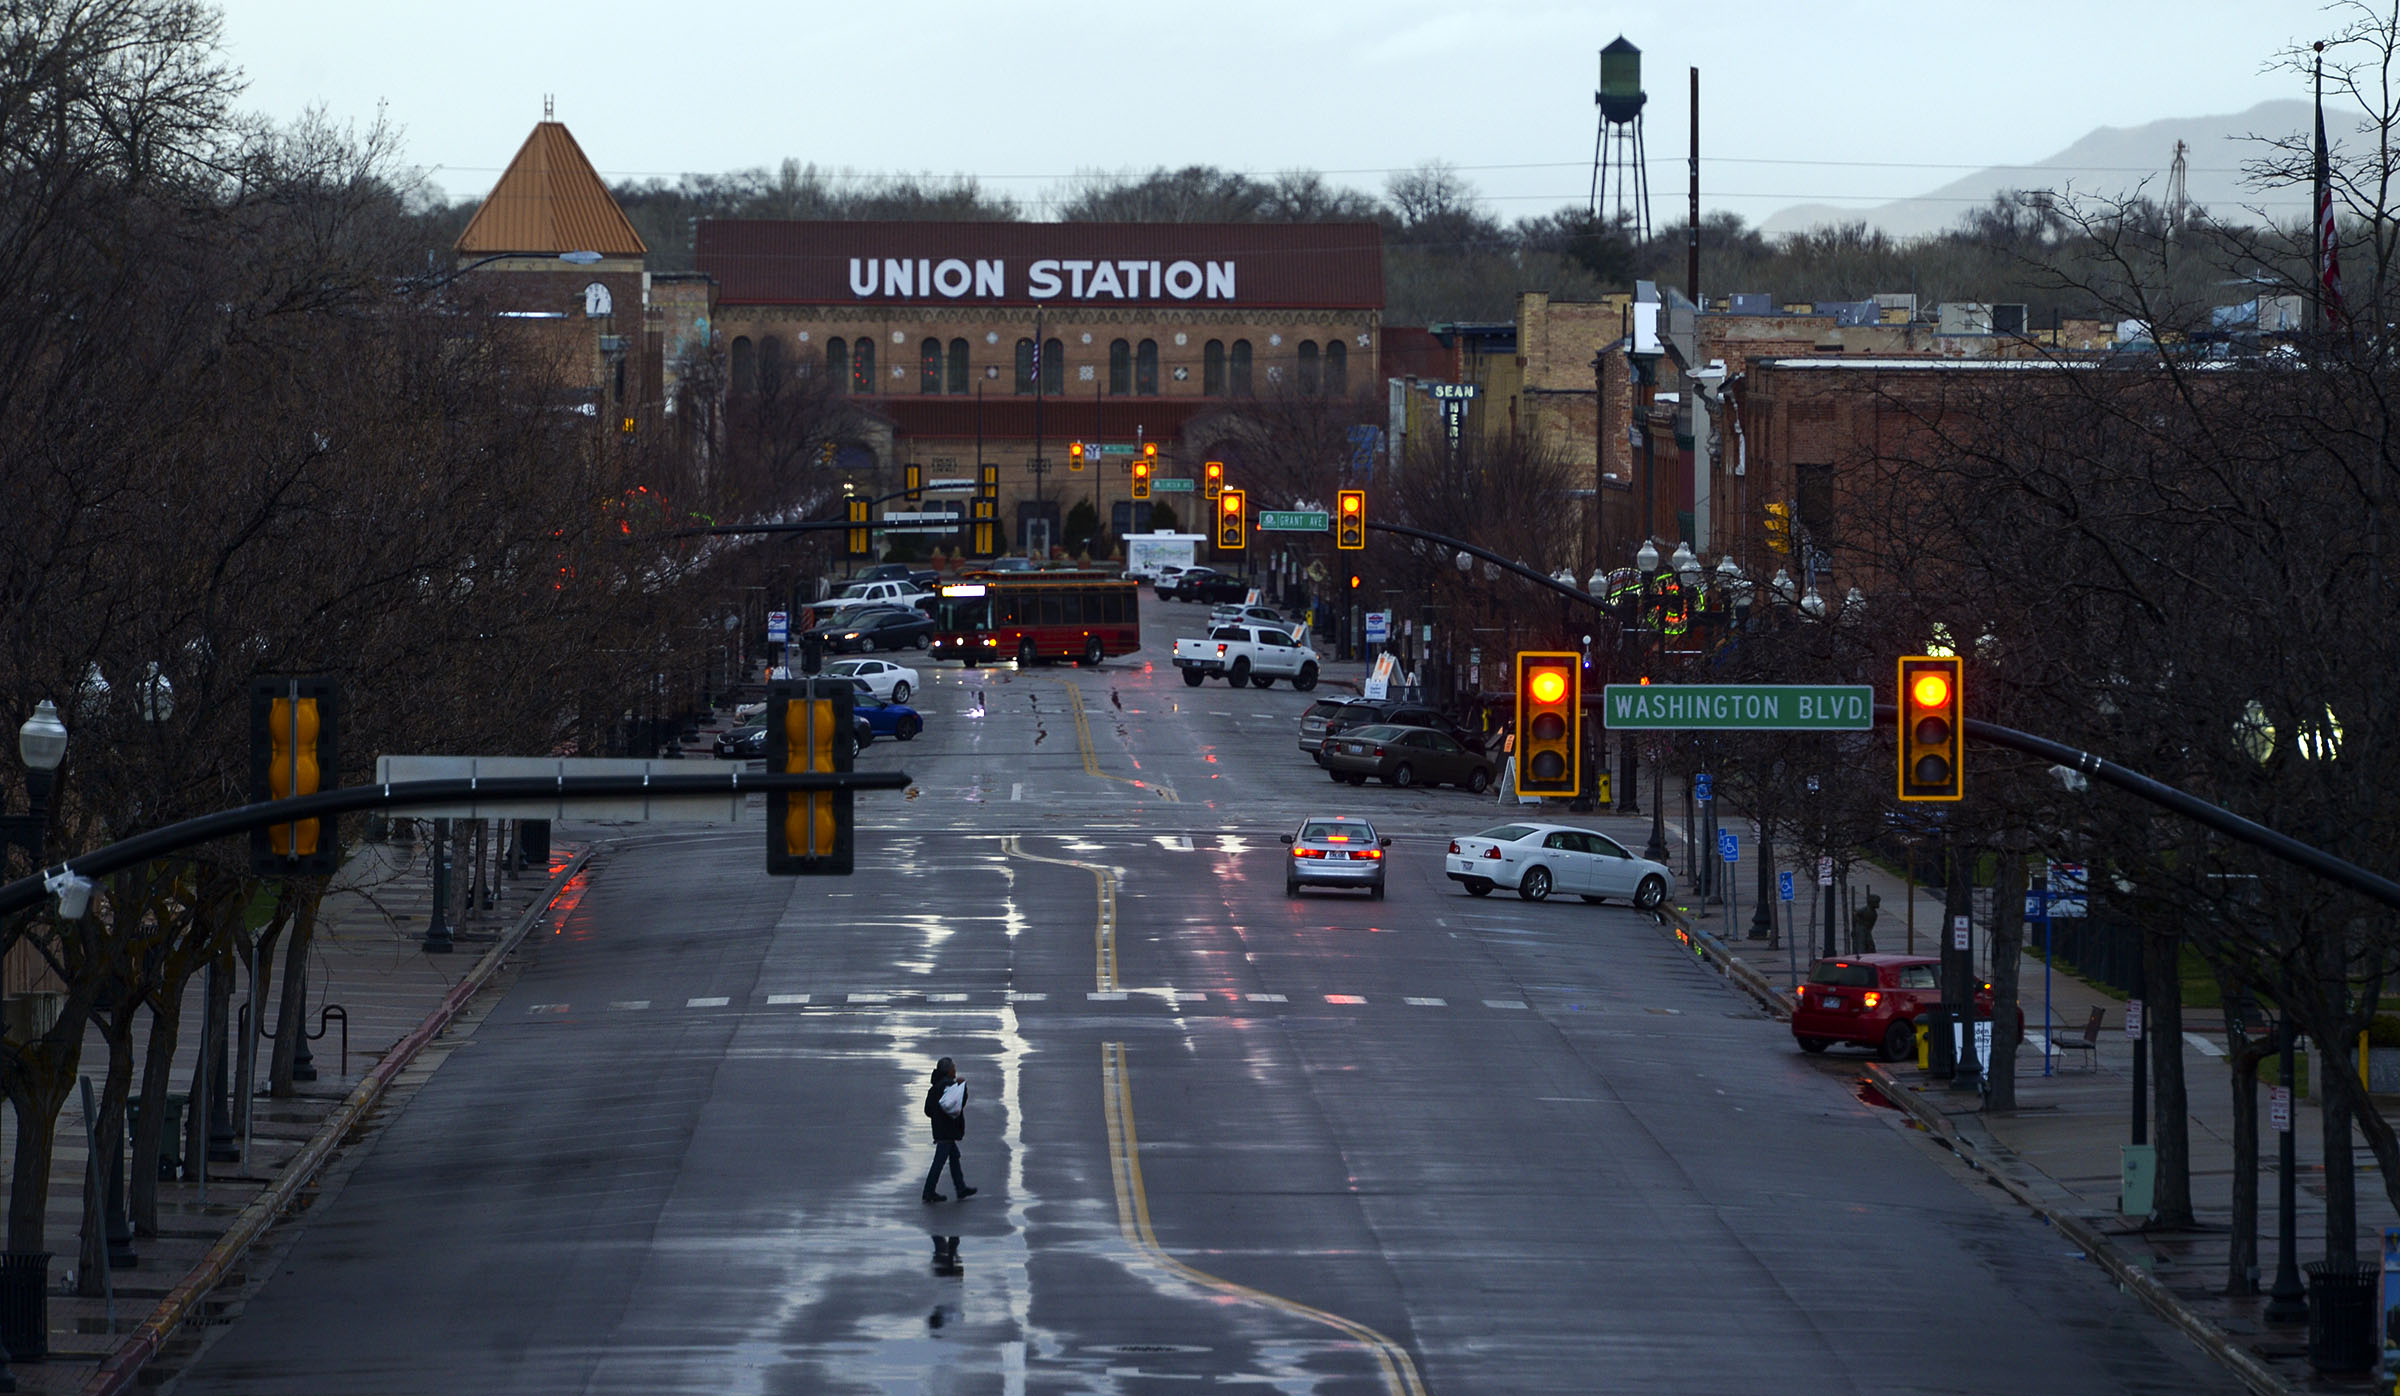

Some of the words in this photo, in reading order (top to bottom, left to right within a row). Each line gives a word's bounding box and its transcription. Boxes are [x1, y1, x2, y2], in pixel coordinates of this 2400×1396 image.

[849, 257, 1005, 298] UNION
[1028, 259, 1236, 299] STATION
[1435, 385, 1474, 398] SEAN
[1279, 514, 1304, 527] GRANT
[1615, 694, 1780, 719] WASHINGTON
[1799, 695, 1868, 720] BLVD.
